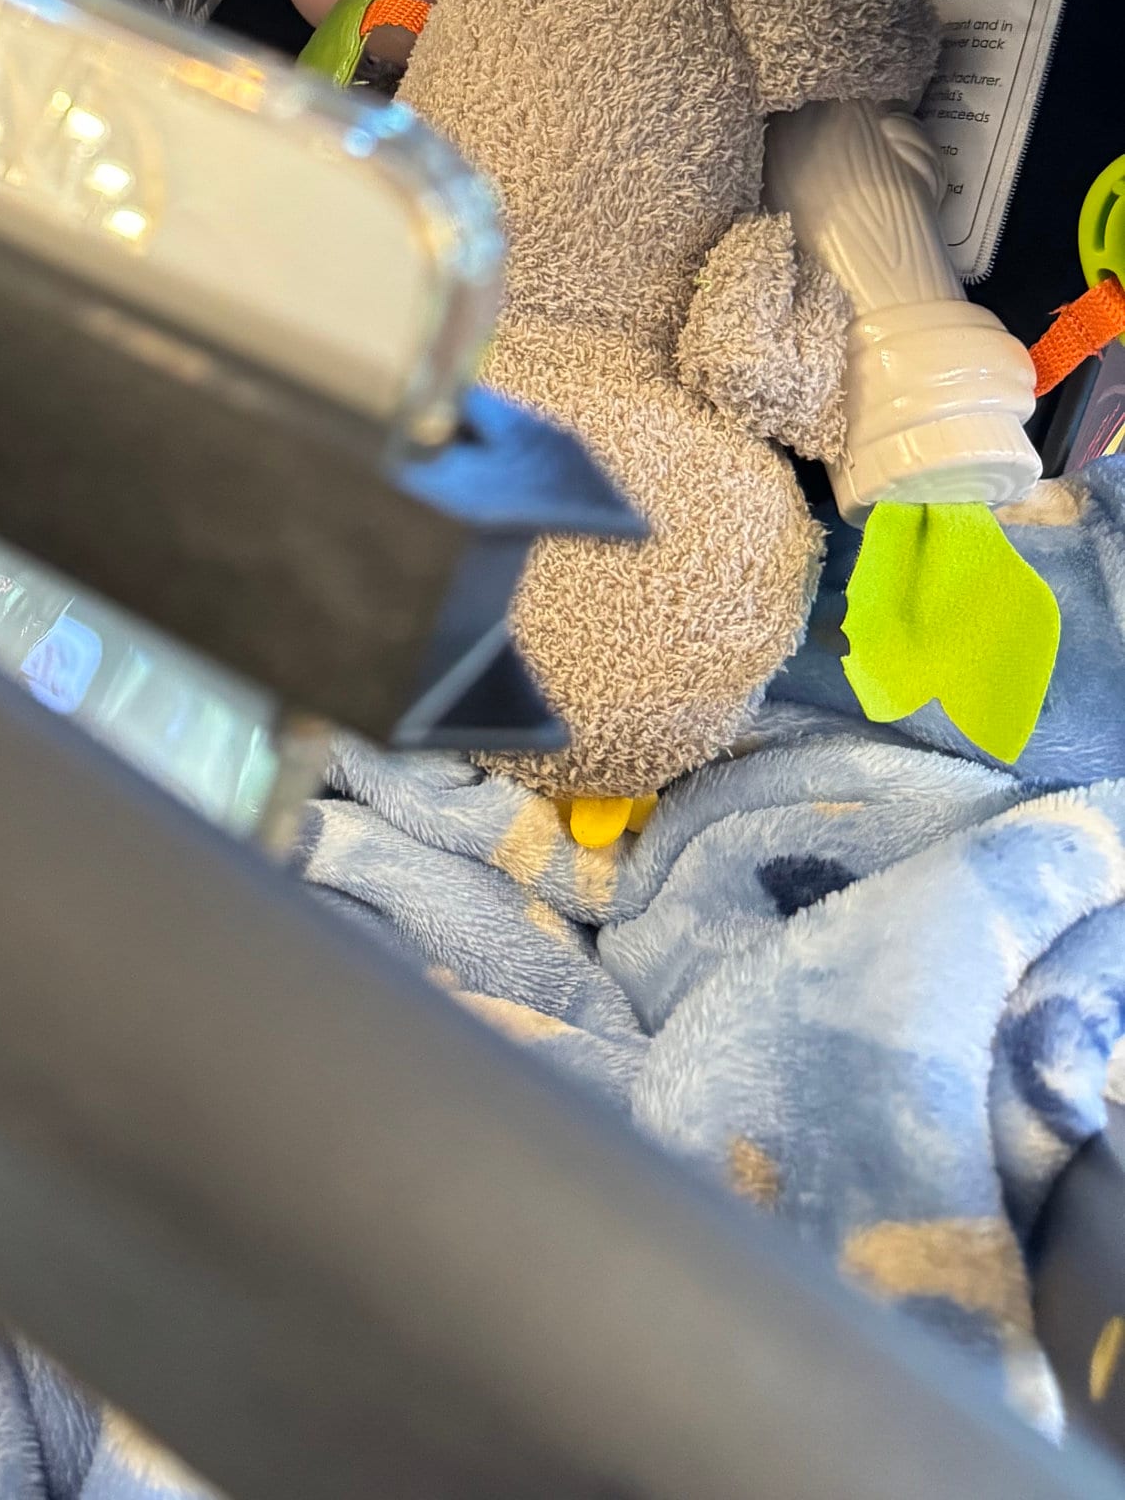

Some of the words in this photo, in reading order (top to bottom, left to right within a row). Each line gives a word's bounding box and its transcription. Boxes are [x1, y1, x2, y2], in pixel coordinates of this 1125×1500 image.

[972, 19, 1000, 32] and
[971, 37, 1006, 50] back
[937, 106, 991, 123] exceeds
